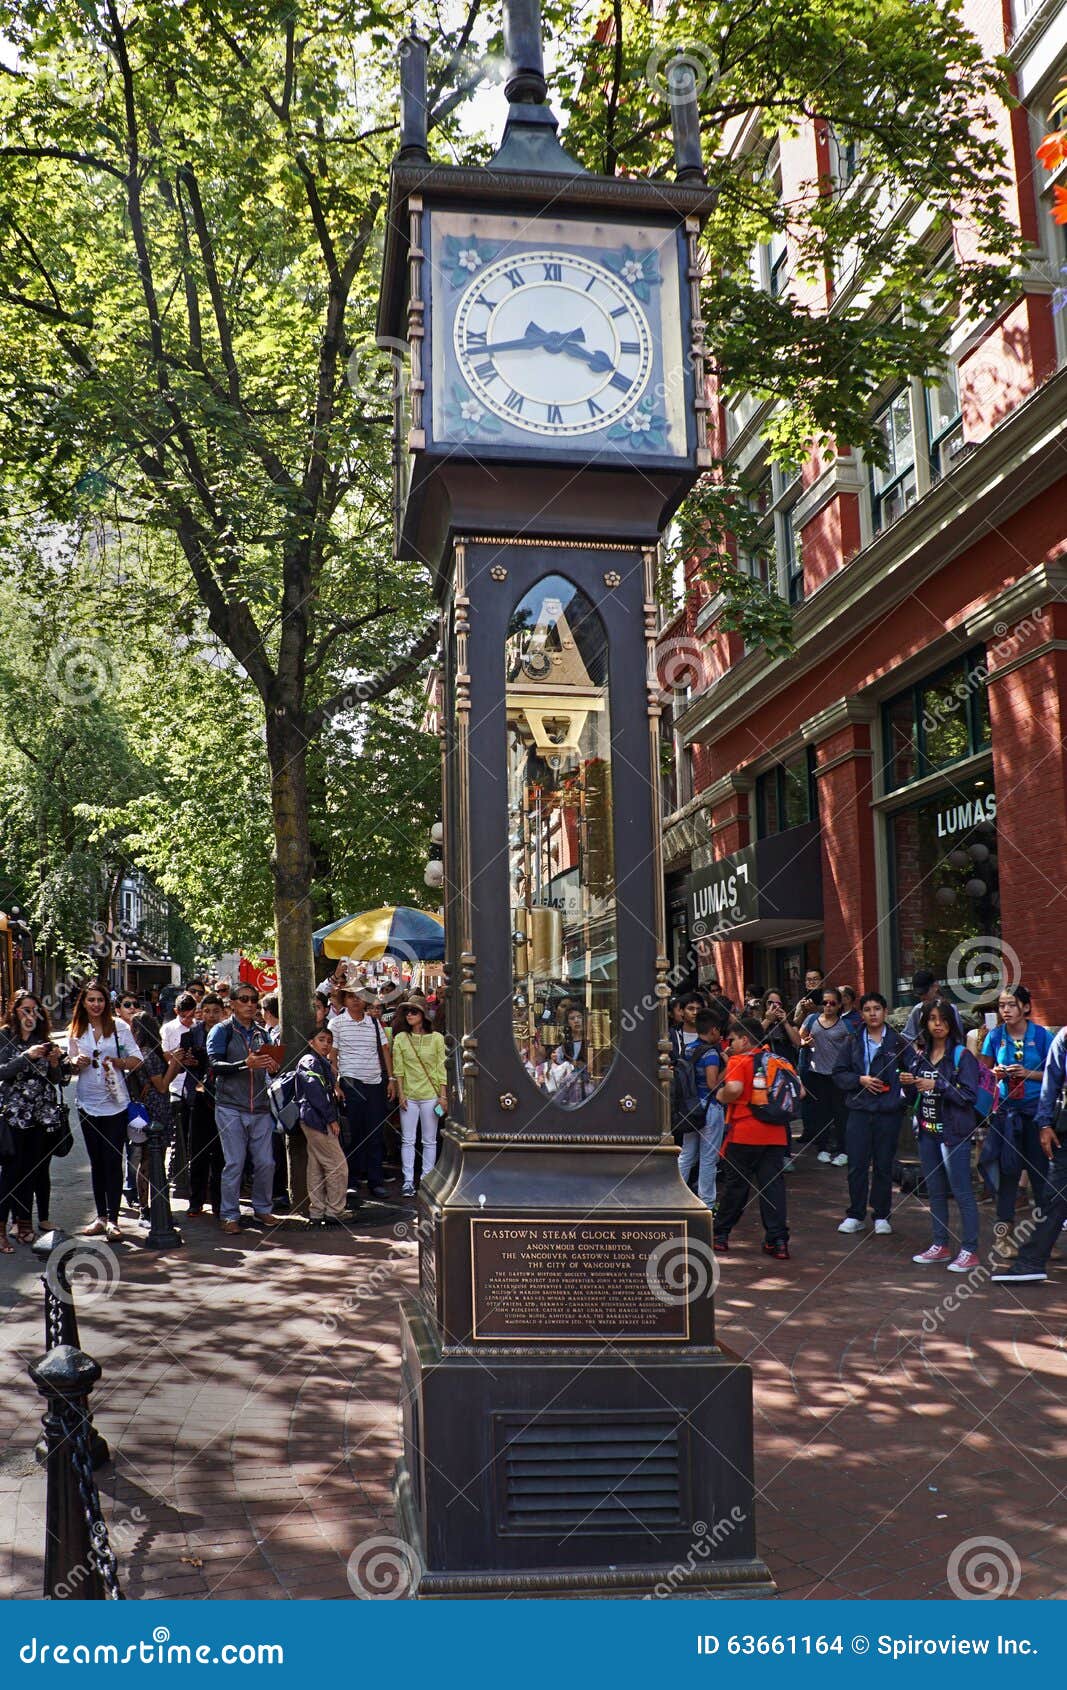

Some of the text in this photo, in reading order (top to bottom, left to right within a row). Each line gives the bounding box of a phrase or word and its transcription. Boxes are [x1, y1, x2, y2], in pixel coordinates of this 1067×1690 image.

[543, 263, 562, 282] XII
[937, 793, 997, 837] LUMAS
[693, 875, 737, 920] LUMAS
[922, 1107, 937, 1119] BE
[483, 1230, 675, 1241] GASTOWN STEAM CLOCK SPONSORS
